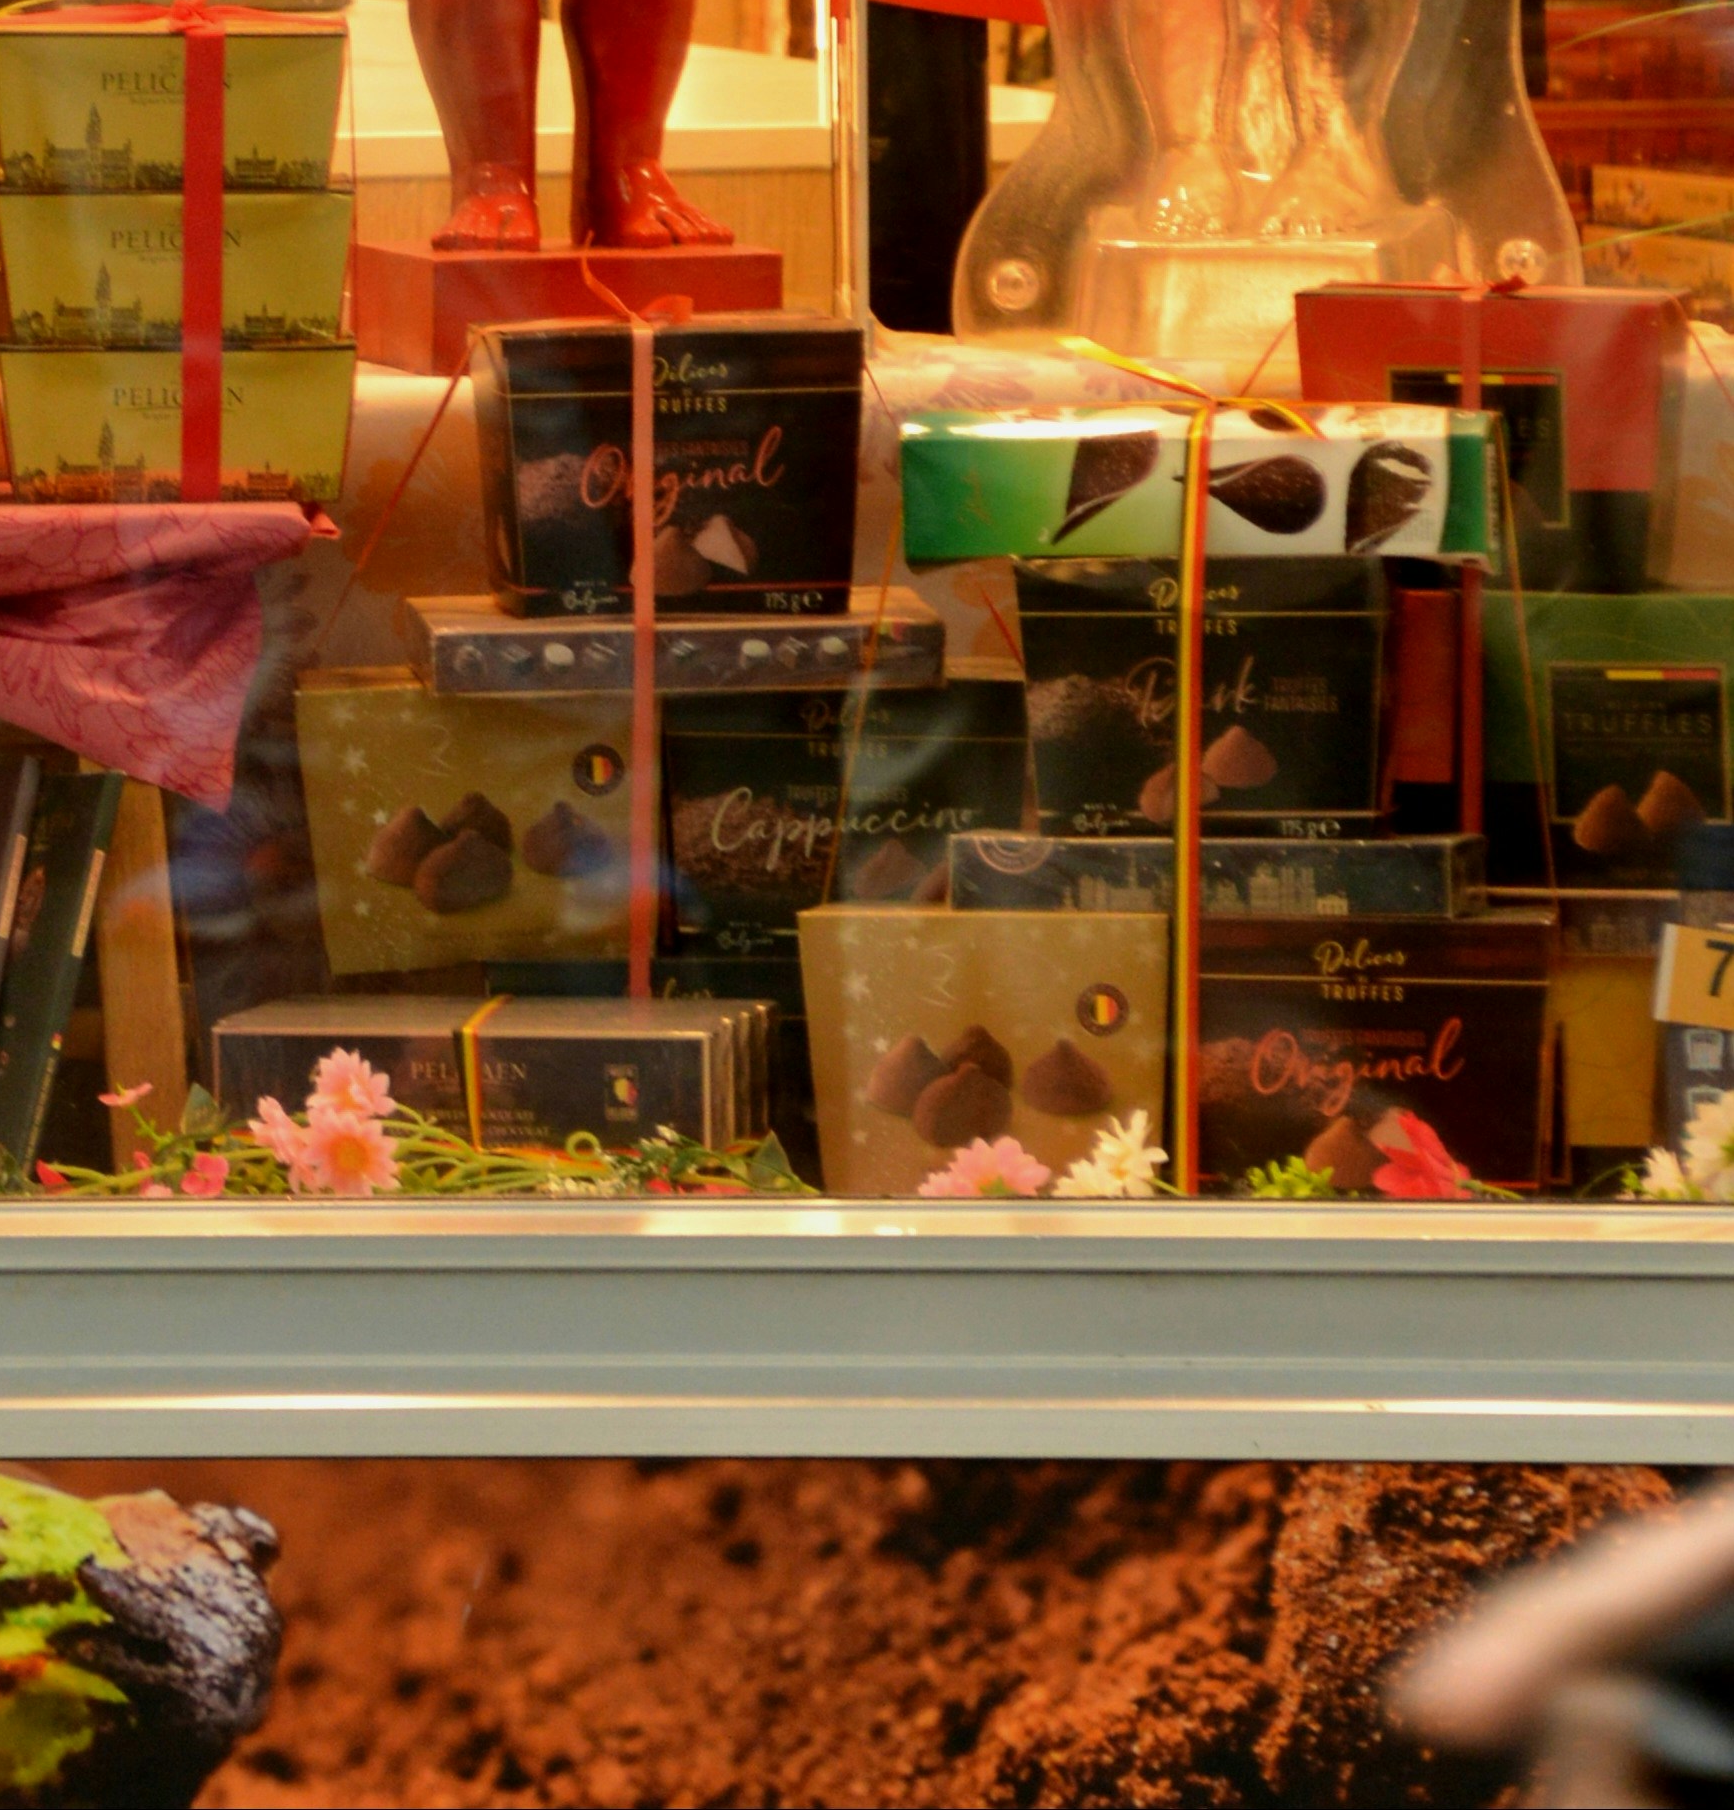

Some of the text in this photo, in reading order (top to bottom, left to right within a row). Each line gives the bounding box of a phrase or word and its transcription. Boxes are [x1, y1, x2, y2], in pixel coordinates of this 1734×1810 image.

[658, 396, 729, 414] RUFFES
[1562, 712, 1713, 736] TRUFFLES
[1320, 983, 1405, 1003] TRUFFES
[410, 1061, 527, 1080] PELAEN
[1251, 1015, 1466, 1118] Original
